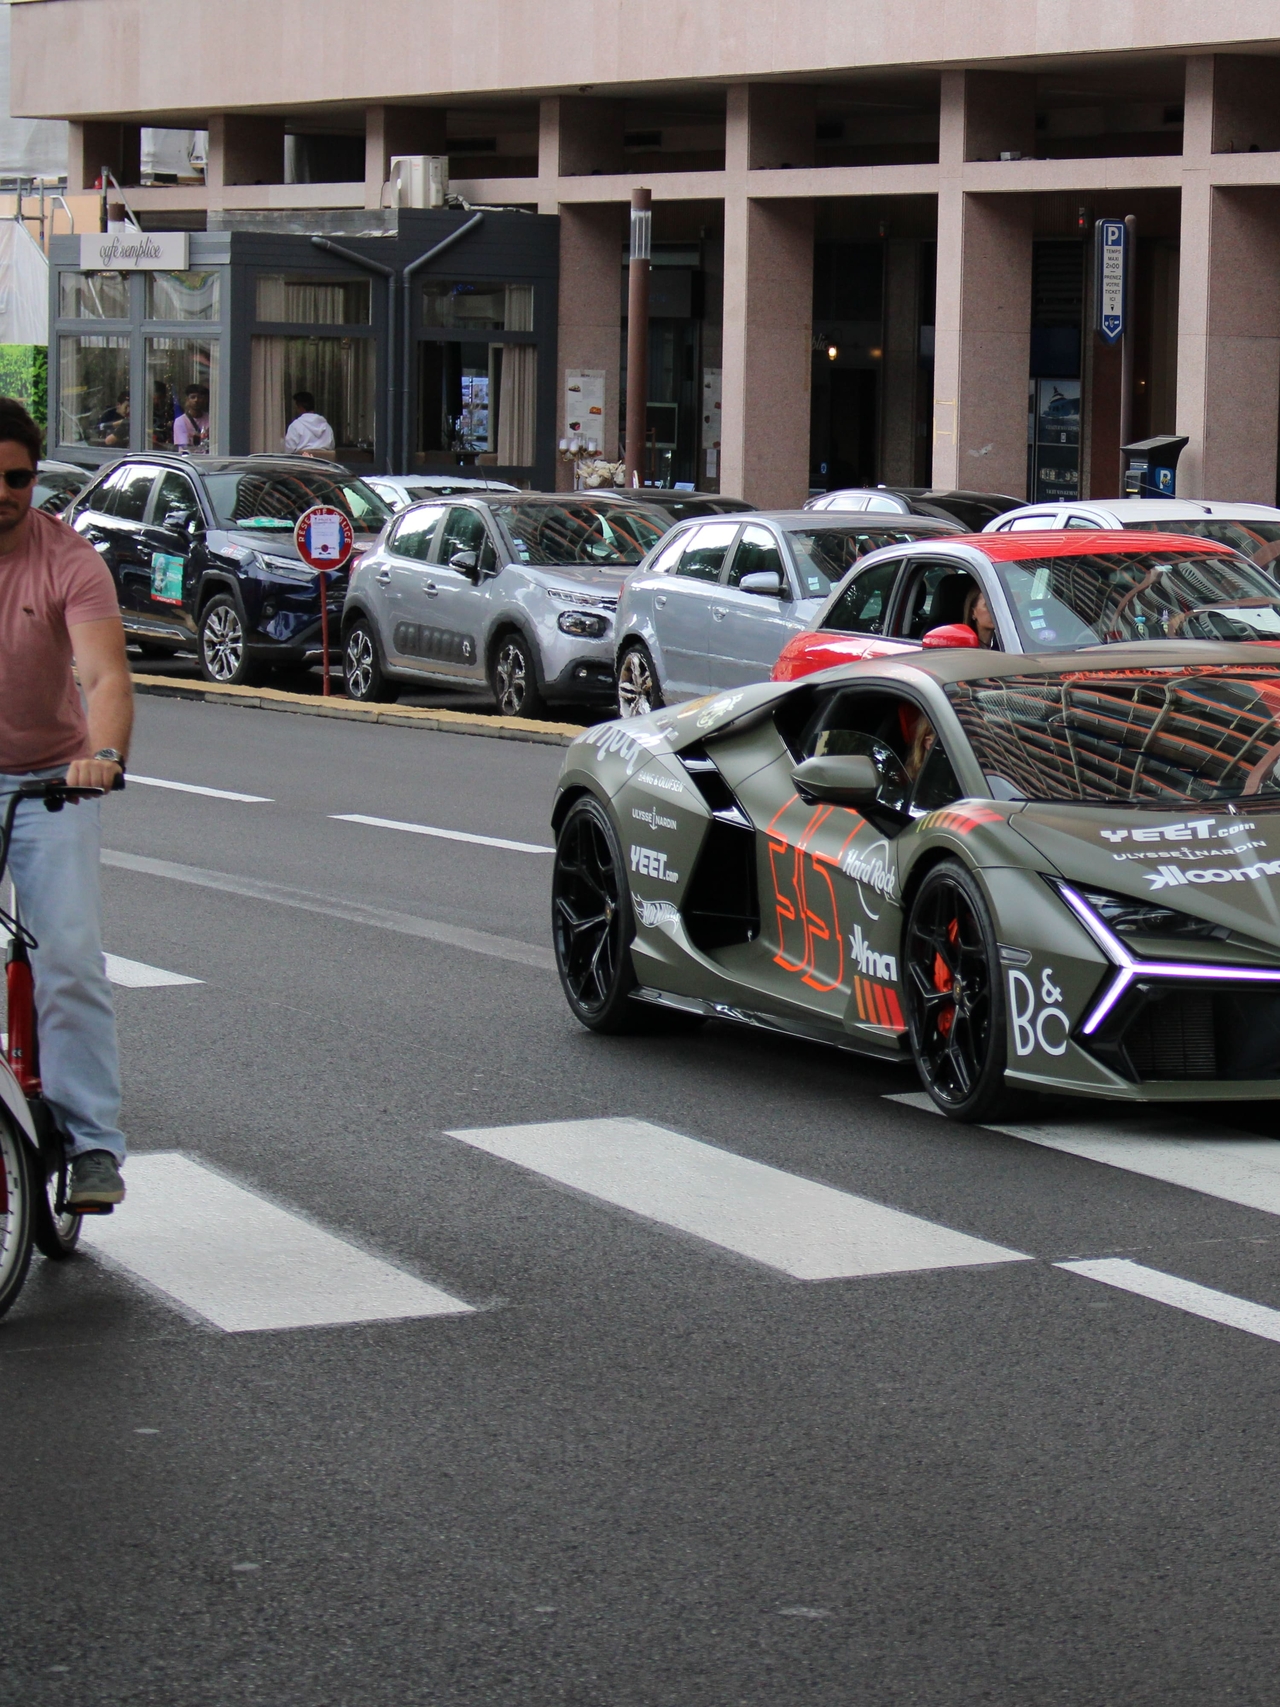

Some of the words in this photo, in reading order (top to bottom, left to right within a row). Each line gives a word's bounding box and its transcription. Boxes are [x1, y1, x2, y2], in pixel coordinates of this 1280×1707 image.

[1108, 226, 1119, 245] P
[120, 236, 161, 267] semplice
[1160, 470, 1171, 489] P
[658, 775, 685, 793] OLUFSEN
[631, 808, 653, 823] ULYSSE
[655, 814, 677, 830] NARDIN
[1112, 850, 1183, 861] ULYSSE
[1197, 840, 1268, 857] NARDIN
[843, 848, 872, 885] Hard
[870, 860, 896, 900] Rock
